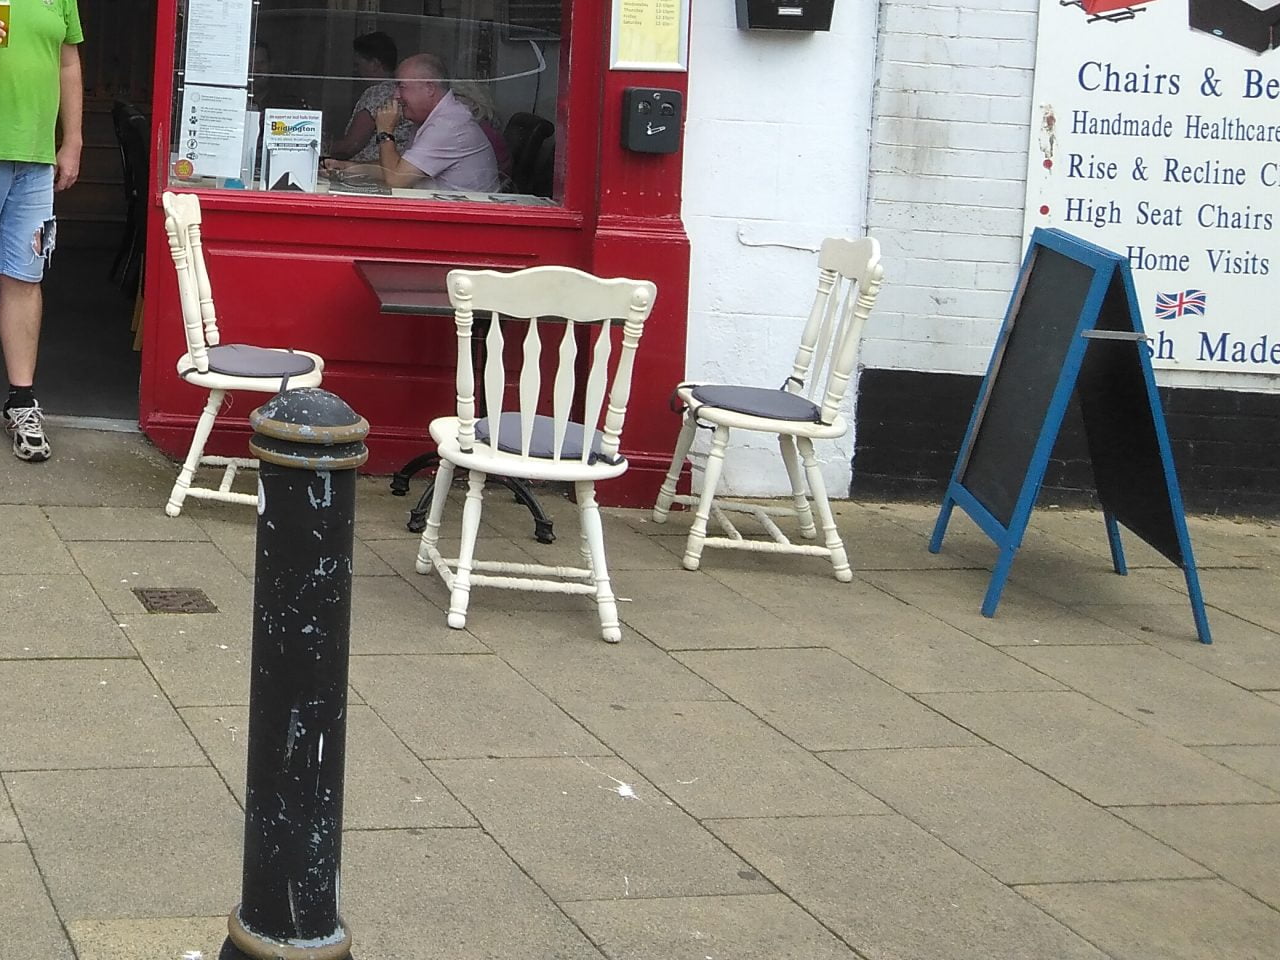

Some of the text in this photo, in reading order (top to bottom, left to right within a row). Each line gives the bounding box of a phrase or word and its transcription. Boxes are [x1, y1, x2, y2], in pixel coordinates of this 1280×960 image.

[1078, 61, 1280, 100] Chairs & Be
[271, 121, 316, 133] Bridlington
[1071, 110, 1280, 143] Handmade Healthcare
[1066, 153, 1280, 187] Rise & Recline C
[1063, 197, 1273, 231] High Seat Chairs
[1126, 245, 1270, 275] Home Visits
[1196, 331, 1280, 365] Made
